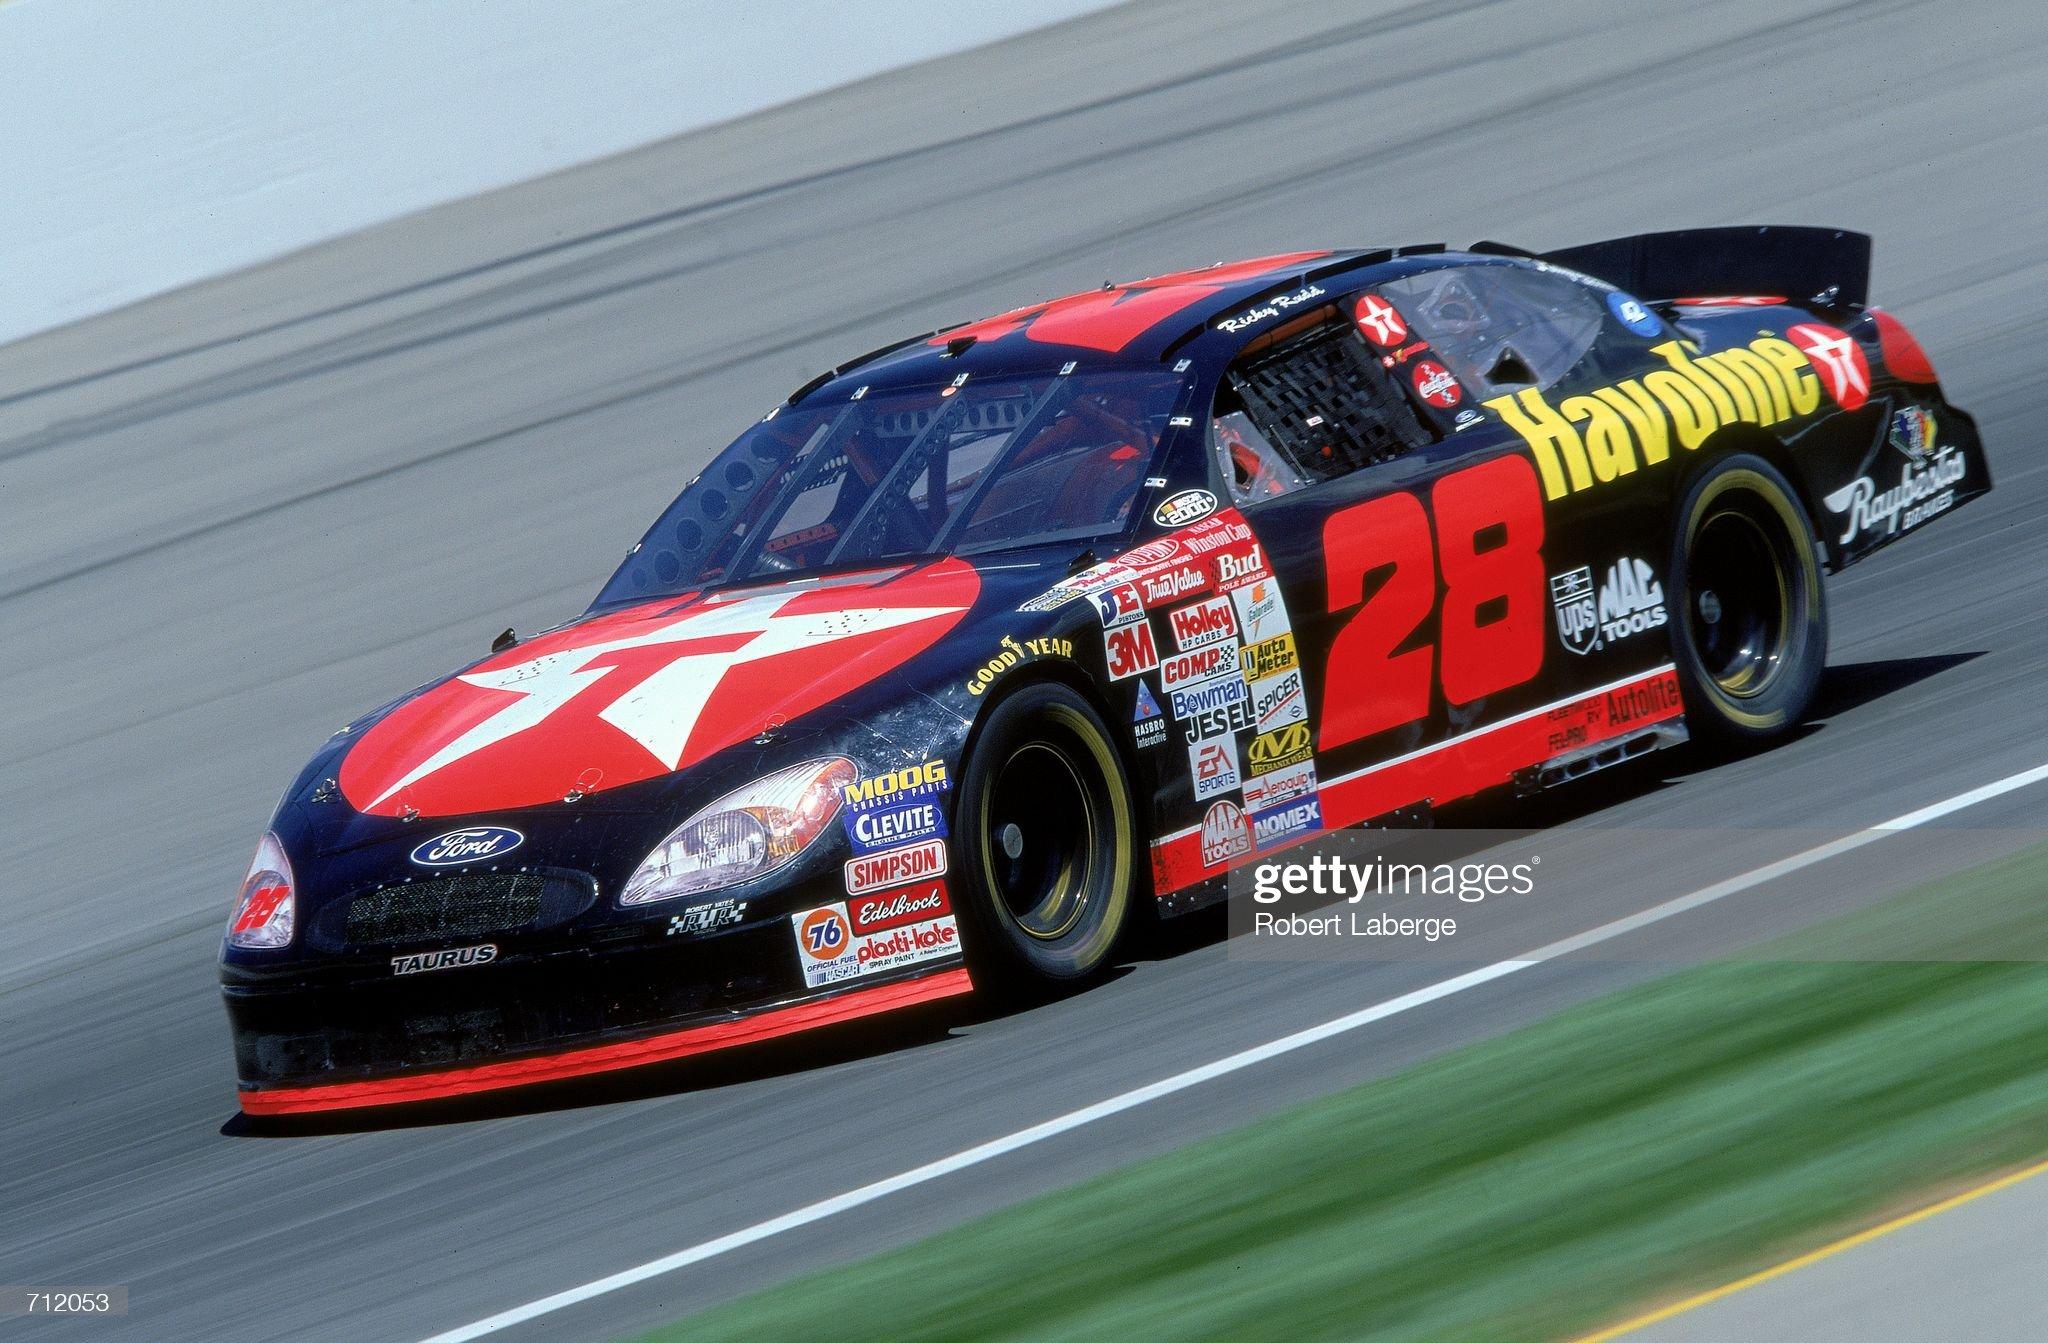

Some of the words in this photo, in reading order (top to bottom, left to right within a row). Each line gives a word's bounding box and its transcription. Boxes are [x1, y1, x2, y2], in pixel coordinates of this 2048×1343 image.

[1217, 307, 1279, 333] Ricky
[1271, 285, 1326, 308] Rudd
[1482, 330, 1821, 501] Havoline
[1166, 498, 1212, 525] 2000
[1187, 517, 1223, 535] NASCAR
[1182, 528, 1232, 555] Winston
[1225, 523, 1252, 540] Cup
[1217, 543, 1263, 582] Bud
[1218, 581, 1240, 593] POLE
[1240, 571, 1268, 583] AWARD
[1600, 556, 1665, 624] MAC
[1118, 611, 1144, 624] PISTONS
[1318, 453, 1545, 752] 28
[1172, 604, 1234, 641] Holley
[1558, 600, 1597, 643] ups
[1601, 606, 1668, 642] TOOLS
[1107, 627, 1158, 678] 3M
[1182, 640, 1193, 650] HP
[1194, 630, 1222, 645] CARBS
[1257, 638, 1286, 659] Auto
[967, 651, 1017, 696] GOOD
[1025, 638, 1073, 658] YEAR
[1164, 647, 1221, 684] COMP
[1204, 661, 1233, 677] CAMS
[1256, 651, 1294, 676] Meter
[1172, 678, 1247, 718] Bowman
[1258, 672, 1300, 718] SPICER
[1607, 677, 1679, 727] Autolite
[1134, 718, 1165, 736] HASBRO
[1185, 699, 1256, 744] JESEL
[1197, 744, 1234, 780] EA
[1251, 758, 1290, 777] MECHANIX
[845, 759, 946, 805] MOOG
[853, 791, 904, 812] CHASSIS
[912, 780, 948, 797] PARTS
[1199, 771, 1236, 793] SPORTS
[855, 805, 935, 842] CLEVITE
[906, 827, 934, 837] PARTS
[1254, 801, 1320, 840] NOMEX
[428, 831, 504, 861] Ford
[1204, 837, 1248, 861] TOOLS
[854, 847, 937, 888] SIMPSON
[859, 888, 942, 926] Edelbrock
[806, 915, 842, 952] 76
[857, 922, 955, 965] plasti-kote
[391, 944, 498, 976] TAURUS
[806, 960, 838, 973] OFFICIAL
[840, 954, 858, 966] FUEL
[869, 959, 893, 970] SPRAY
[894, 953, 915, 965] PAINT
